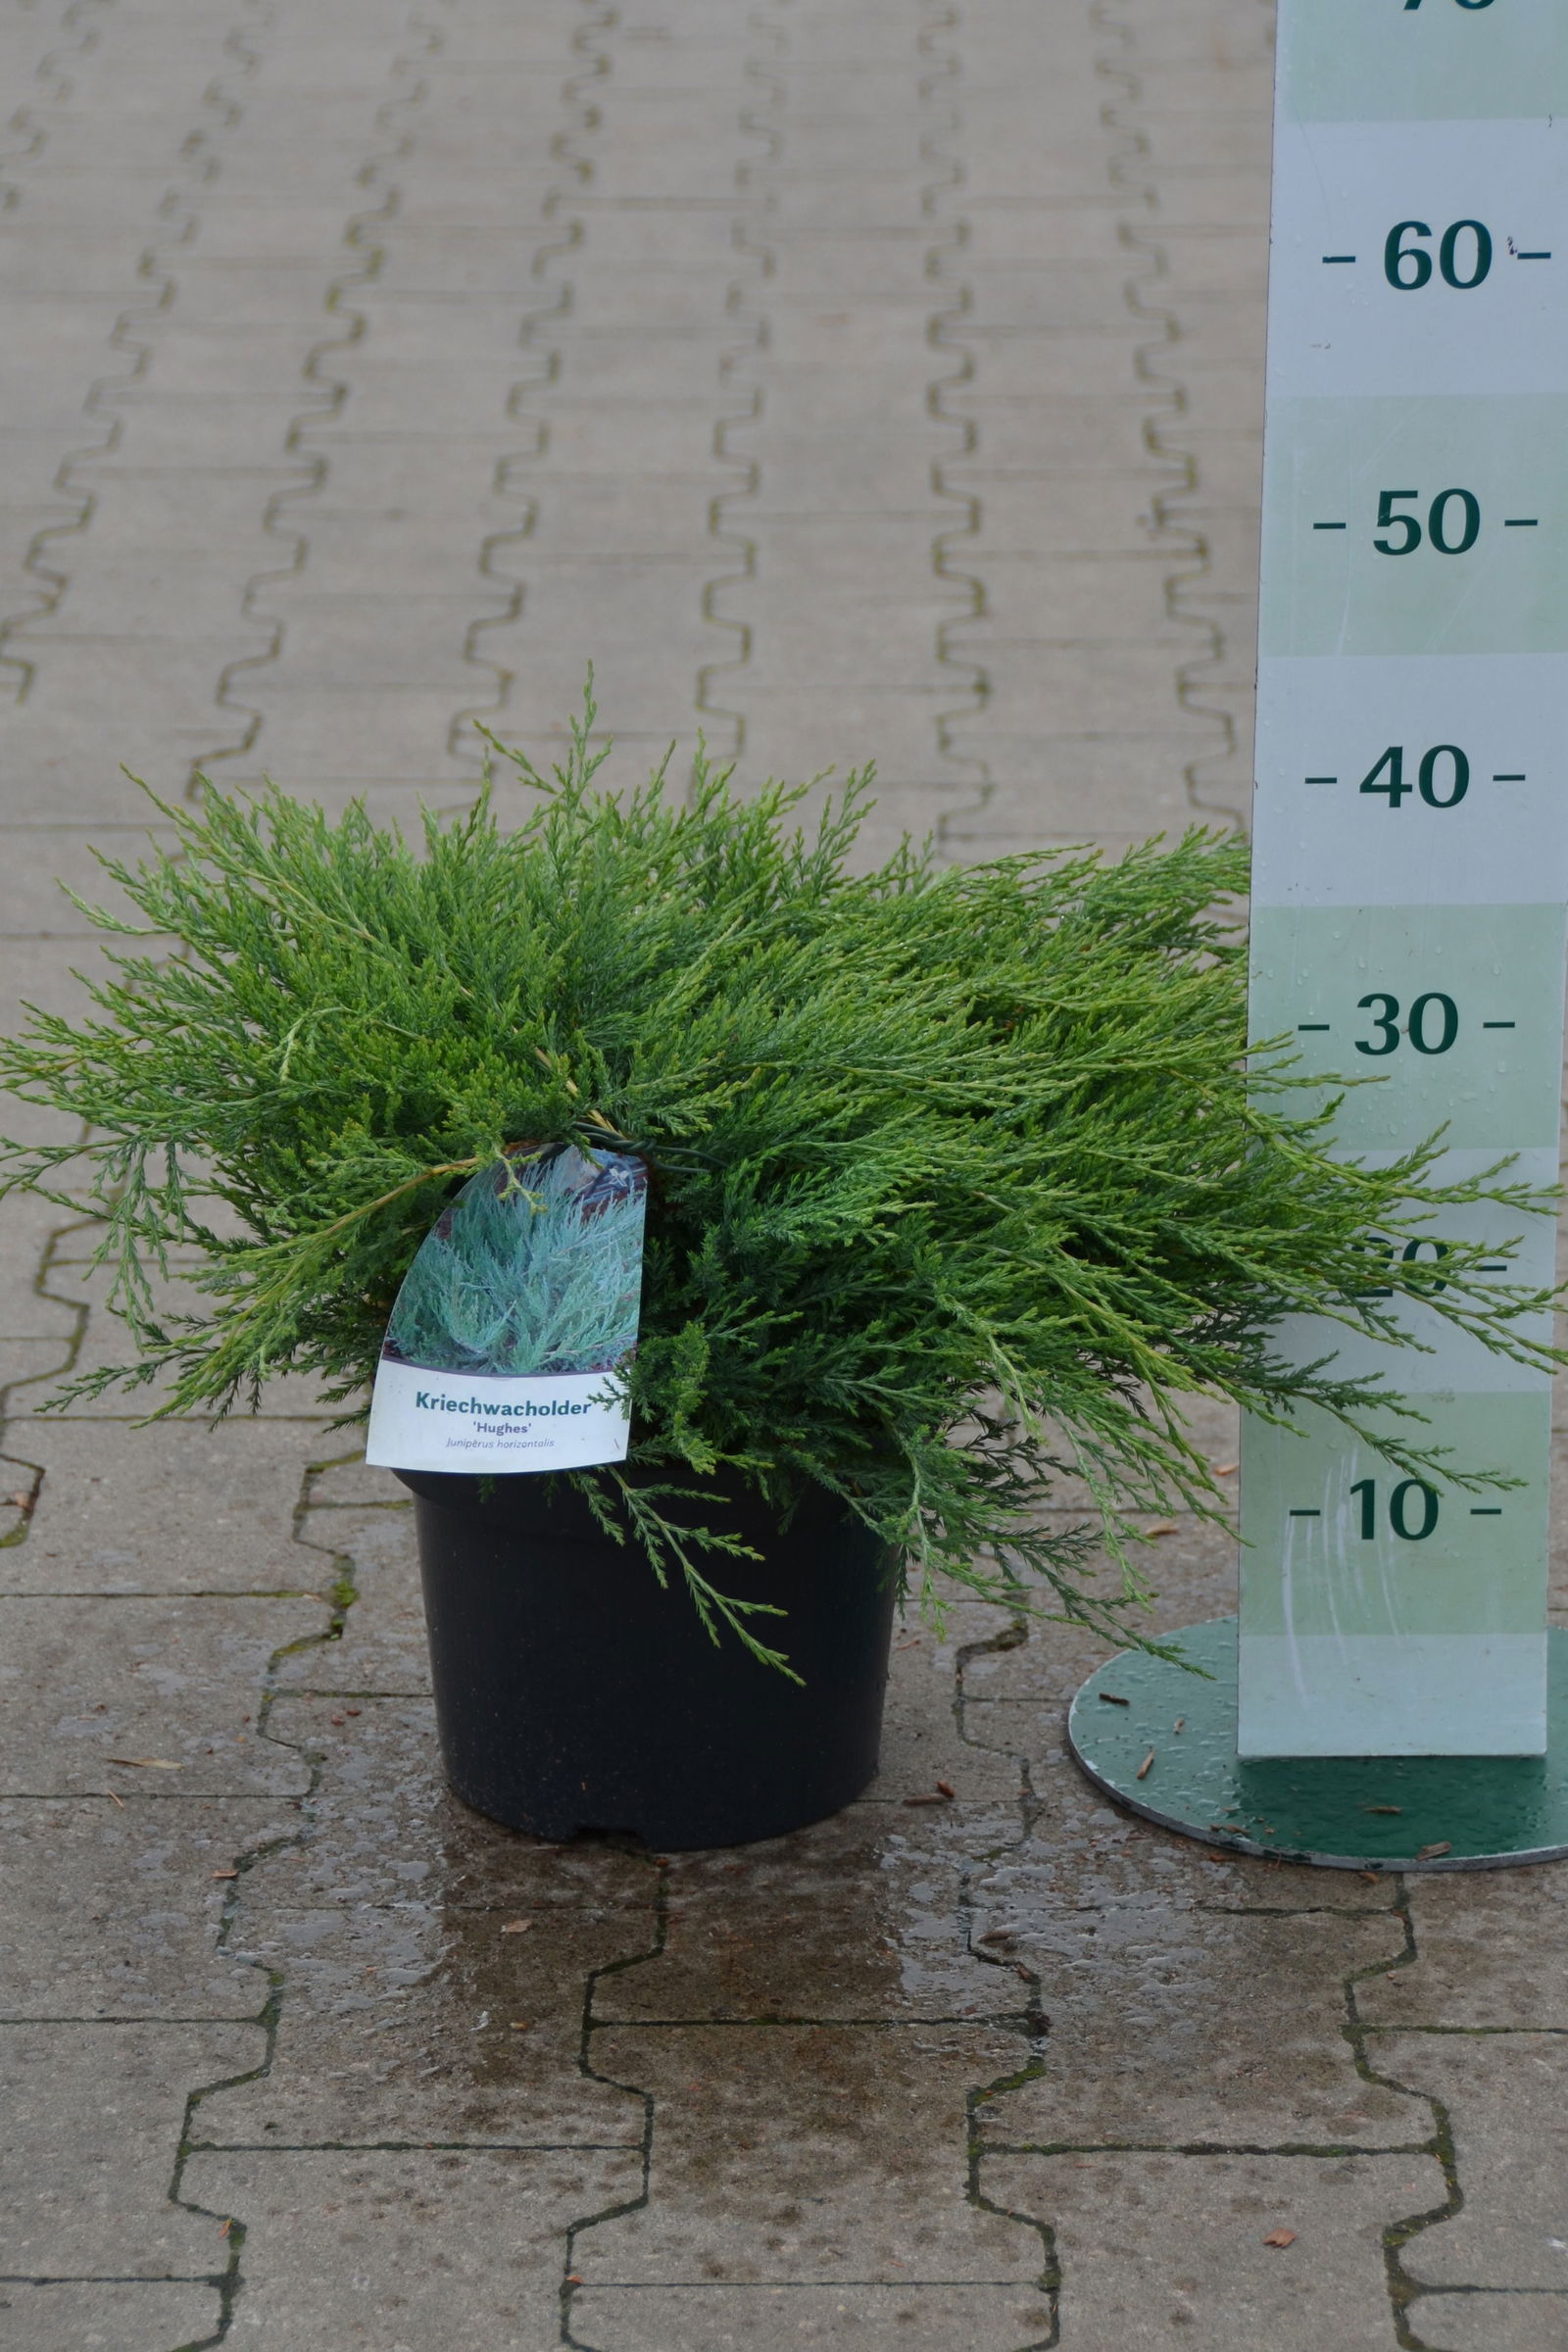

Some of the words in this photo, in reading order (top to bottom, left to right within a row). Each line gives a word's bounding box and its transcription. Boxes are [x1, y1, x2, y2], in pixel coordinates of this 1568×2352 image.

[1384, 220, 1493, 290] 60
[1373, 488, 1481, 556] 50
[1359, 745, 1470, 808] 40
[1354, 992, 1459, 1055] 30
[416, 1391, 592, 1417] Kriechwacholder
[473, 1421, 532, 1437] 'Hughes'
[496, 1438, 555, 1449] horizontalis
[1349, 1478, 1439, 1541] 10
